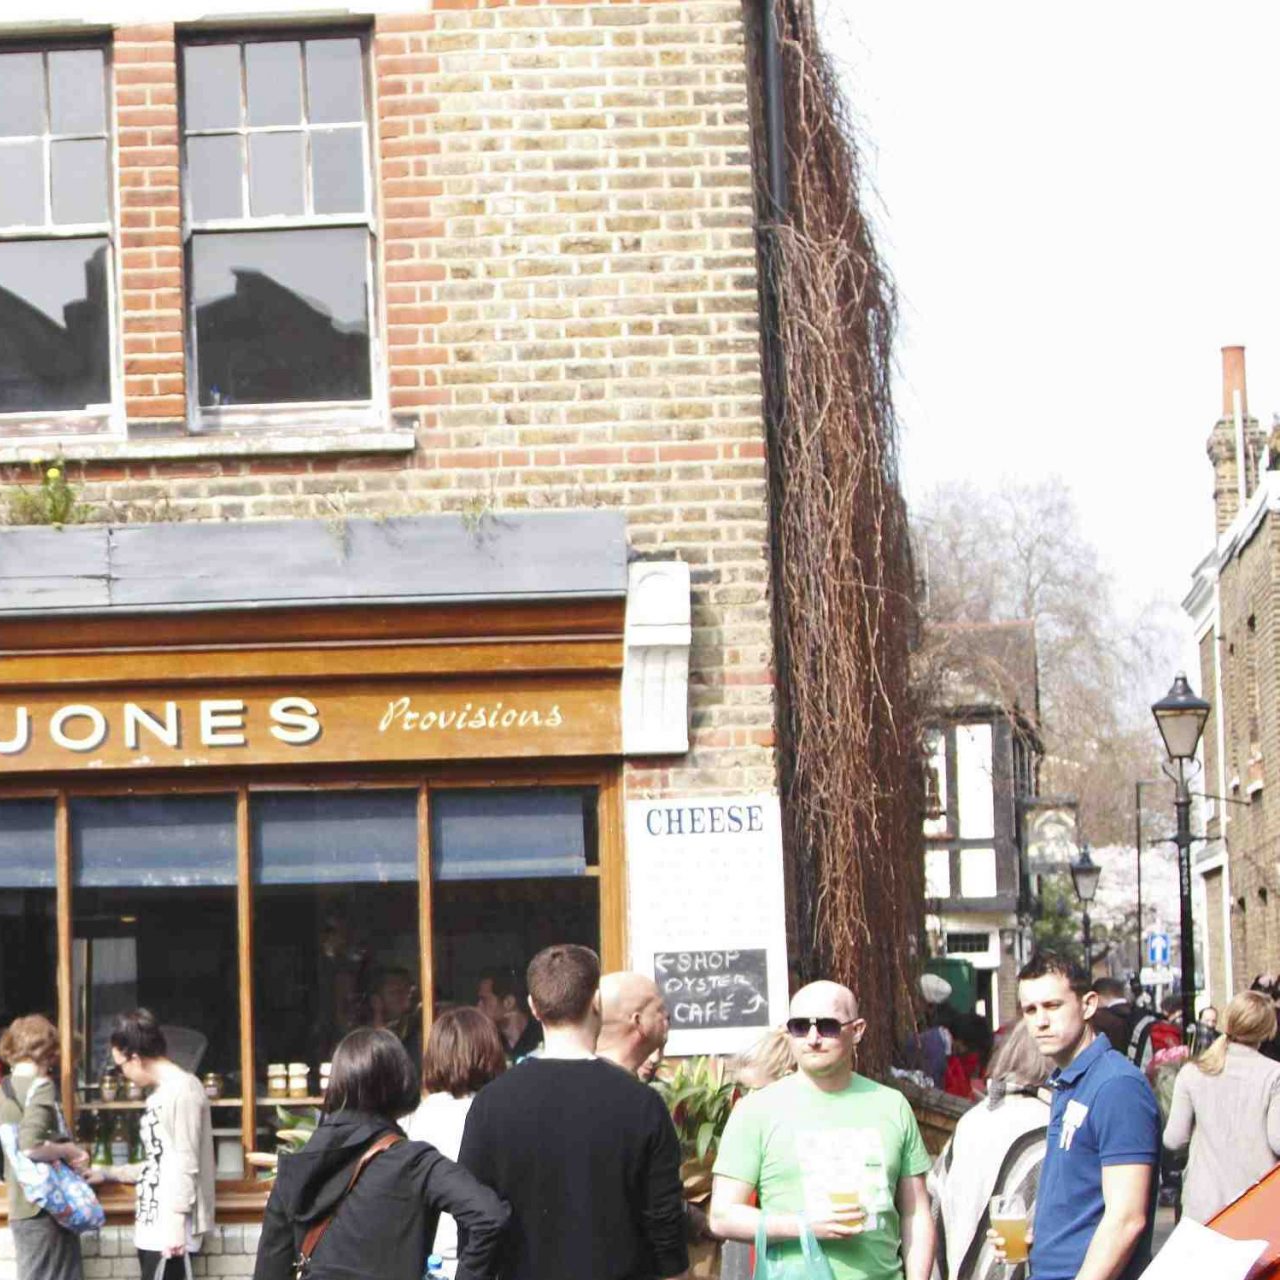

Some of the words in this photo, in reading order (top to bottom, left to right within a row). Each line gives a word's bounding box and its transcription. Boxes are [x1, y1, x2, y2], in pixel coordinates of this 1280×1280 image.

[378, 697, 564, 732] Provisions
[646, 804, 764, 836] CHEESE
[677, 950, 740, 973] SHOP
[664, 974, 751, 995] OYSTER
[674, 993, 735, 1025] CAFÉ
